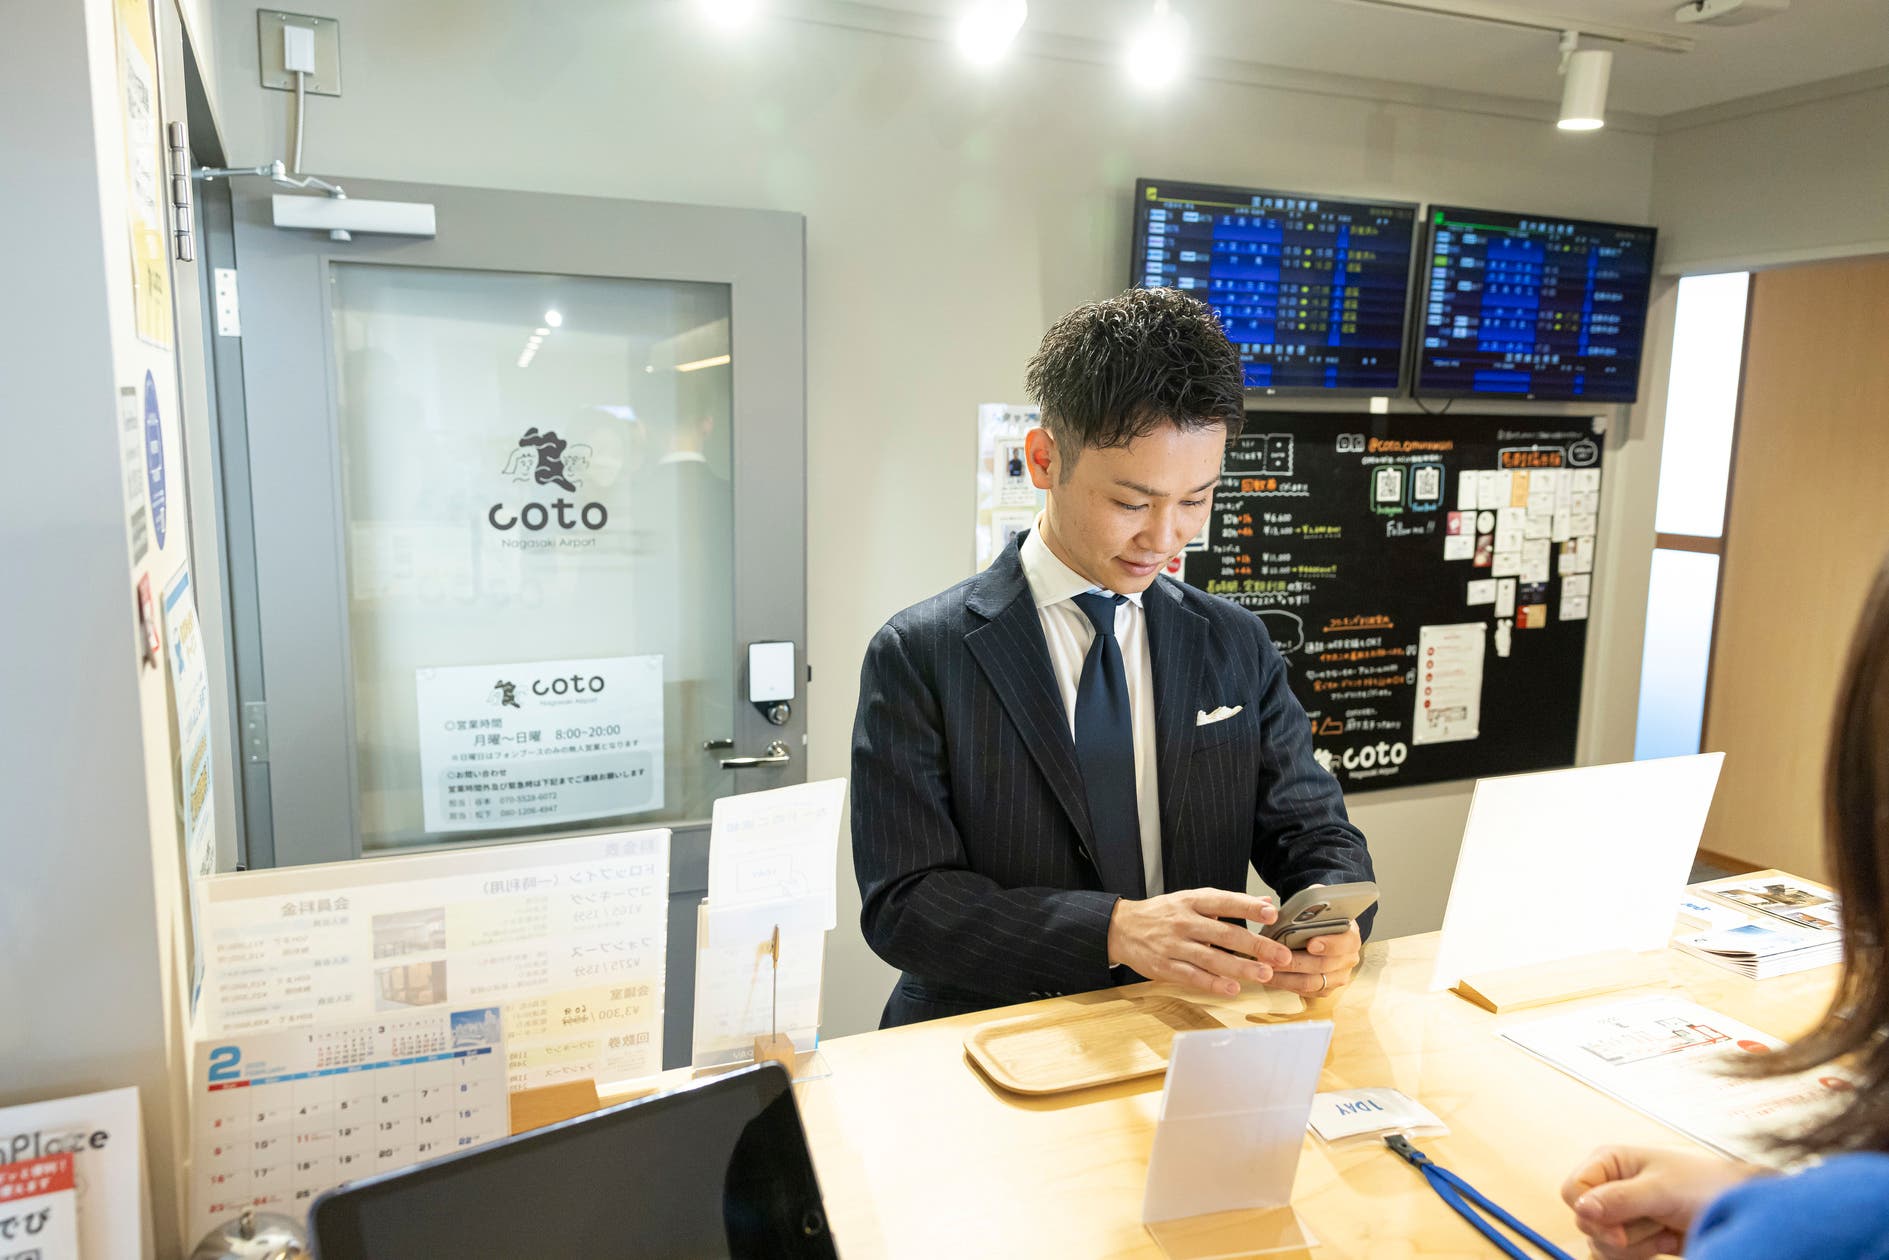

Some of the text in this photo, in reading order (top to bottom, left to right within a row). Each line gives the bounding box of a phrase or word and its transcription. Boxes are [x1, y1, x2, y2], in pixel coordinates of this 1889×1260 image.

[489, 498, 608, 530] coto
[502, 537, 596, 550] Nagasaki Airport
[532, 675, 605, 696] coto
[1342, 741, 1407, 770] coto
[208, 1046, 241, 1082] 2
[421, 1090, 428, 1098] 7
[419, 1116, 432, 1125] 14
